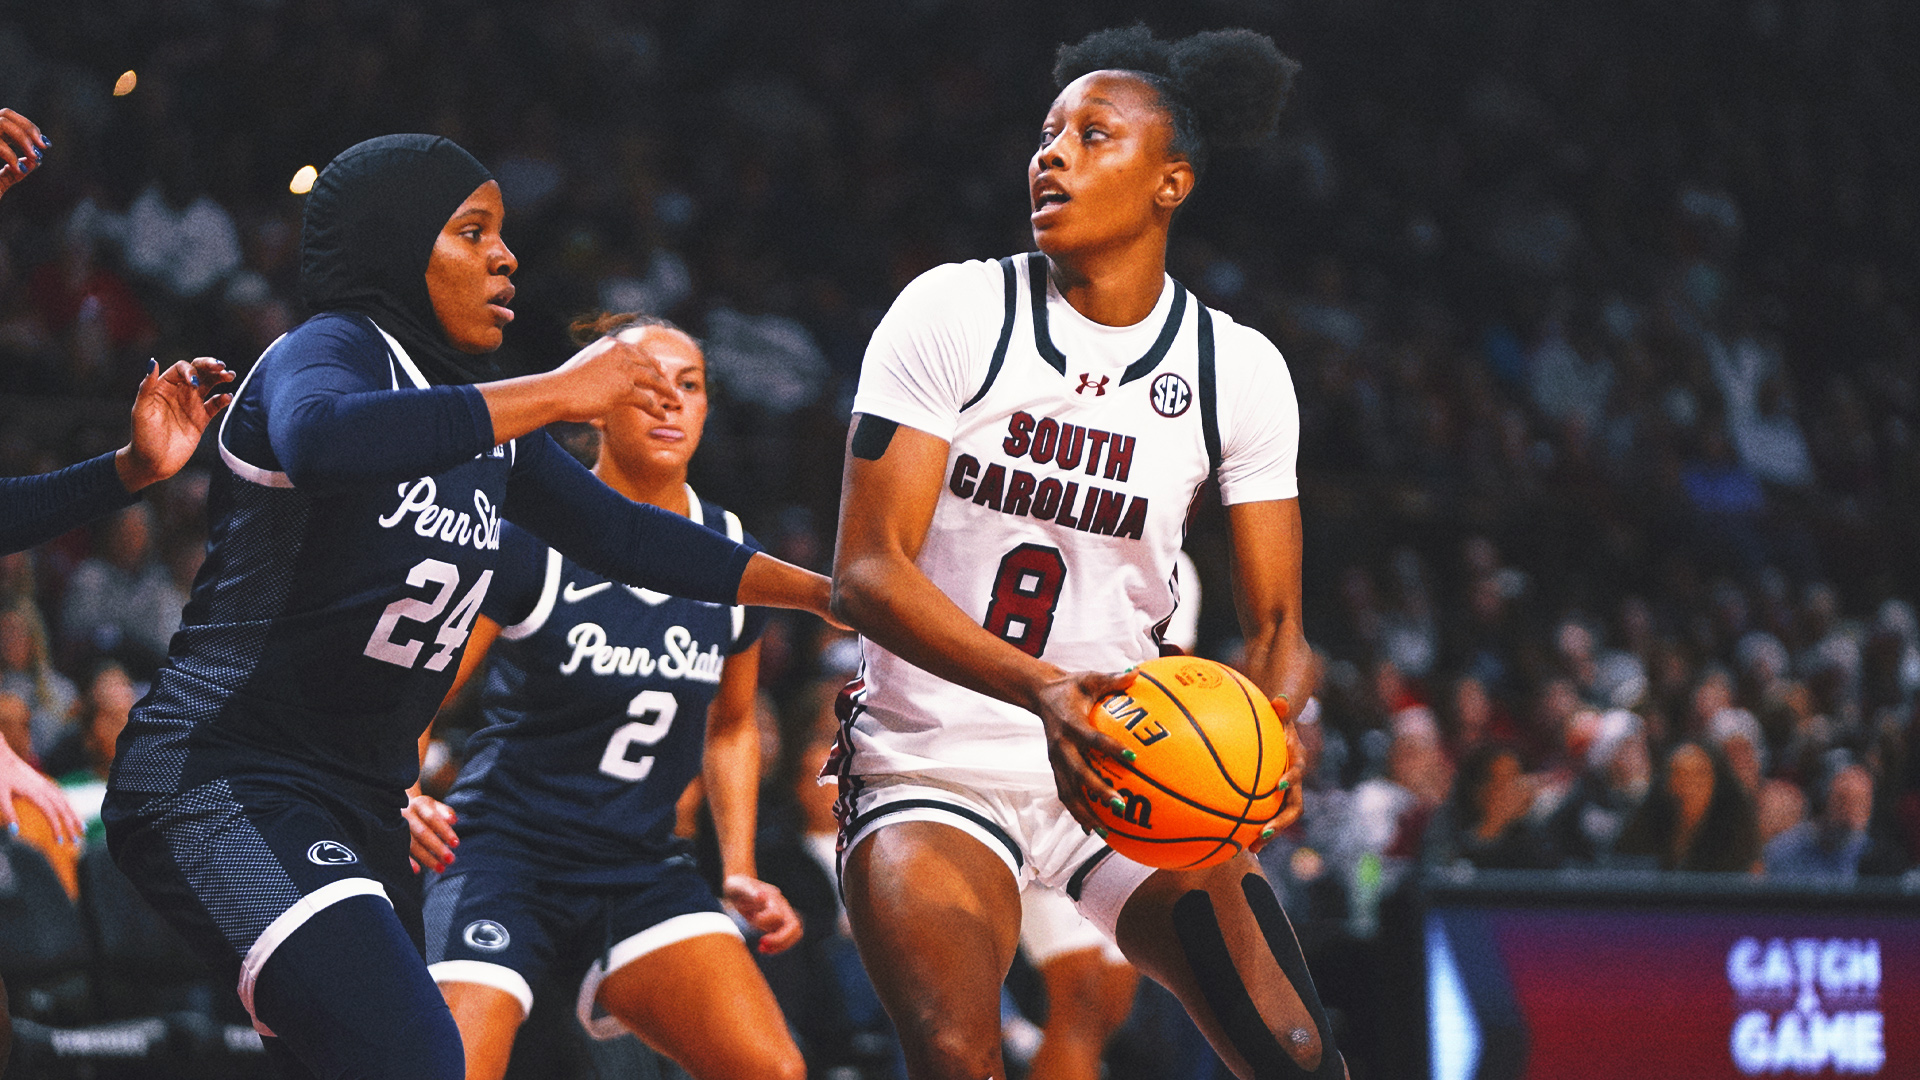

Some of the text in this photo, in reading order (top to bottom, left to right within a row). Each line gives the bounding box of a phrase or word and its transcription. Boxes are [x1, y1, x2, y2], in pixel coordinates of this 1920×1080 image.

[1153, 375, 1189, 414] SEC
[1002, 410, 1136, 483] SOUTH
[378, 476, 501, 550] Penn Sta
[949, 453, 1148, 541] CAROLINA
[363, 558, 494, 672] 24
[982, 542, 1067, 659] 8
[560, 622, 656, 677] Penn
[598, 689, 678, 782] 2
[1726, 936, 1882, 991] CATCH
[1730, 1009, 1886, 1076] GAME
